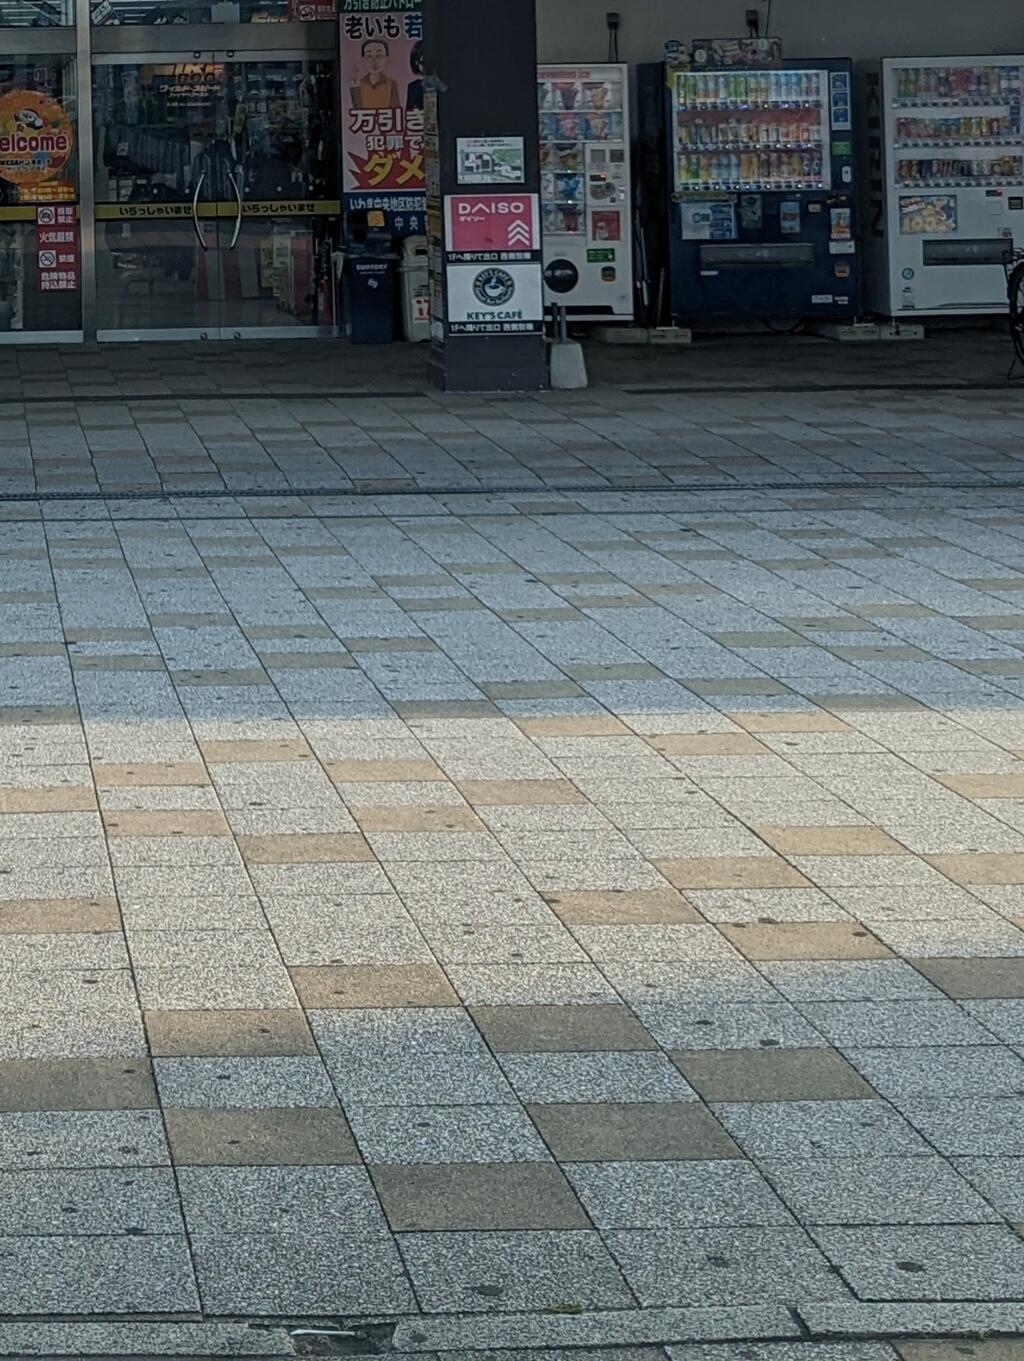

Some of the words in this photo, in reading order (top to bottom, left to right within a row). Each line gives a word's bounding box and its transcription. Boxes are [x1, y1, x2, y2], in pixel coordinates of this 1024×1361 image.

[345, 15, 400, 39] 老いも
[349, 107, 424, 133] 万引き
[363, 152, 426, 186] ダメ
[119, 204, 192, 216] いらっしゃいませ
[242, 203, 315, 213] いらっしゃいませ
[458, 202, 524, 215] DAISO
[355, 263, 388, 271] SUNTORY
[466, 311, 496, 320] KEY'S
